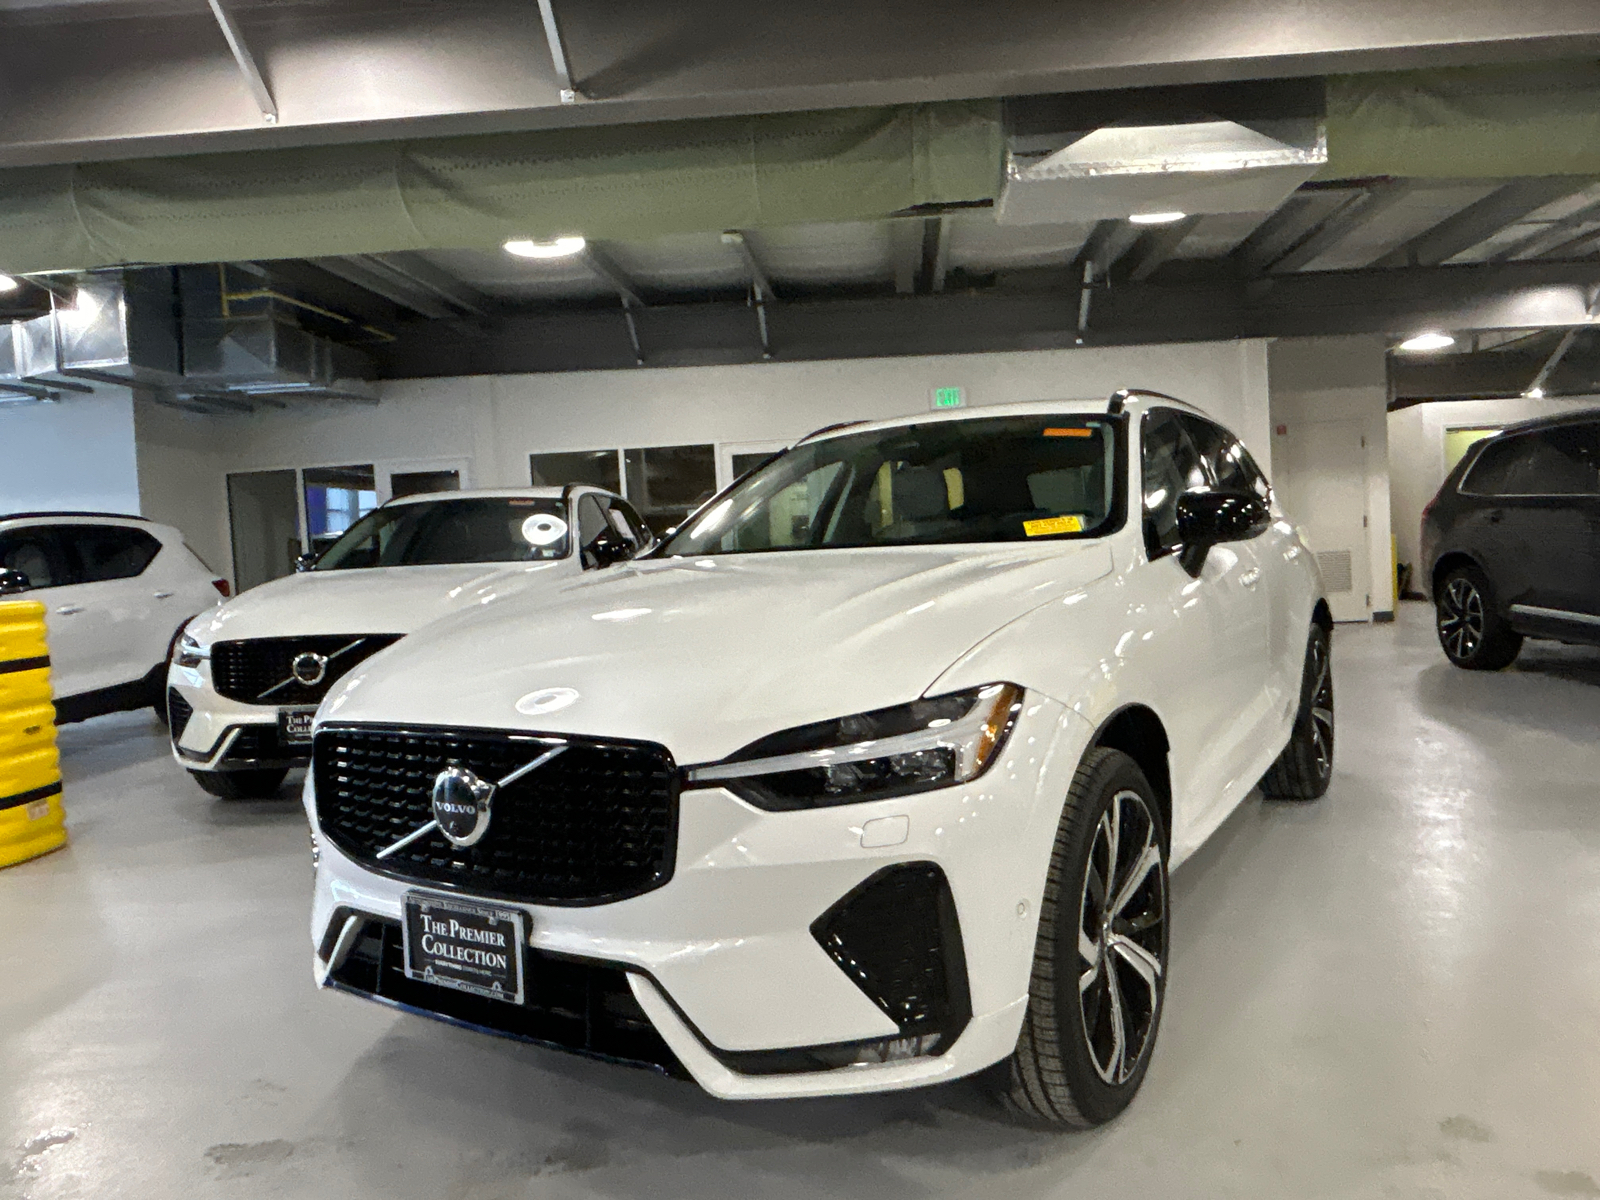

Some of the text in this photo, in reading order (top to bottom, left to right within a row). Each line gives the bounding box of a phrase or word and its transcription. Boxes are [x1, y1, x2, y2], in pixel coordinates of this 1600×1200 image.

[936, 387, 960, 406] EXIT
[286, 715, 303, 725] THE
[436, 801, 475, 815] VOLVO
[420, 914, 506, 947] THE PREMIER
[421, 934, 507, 969] COLLECTION
